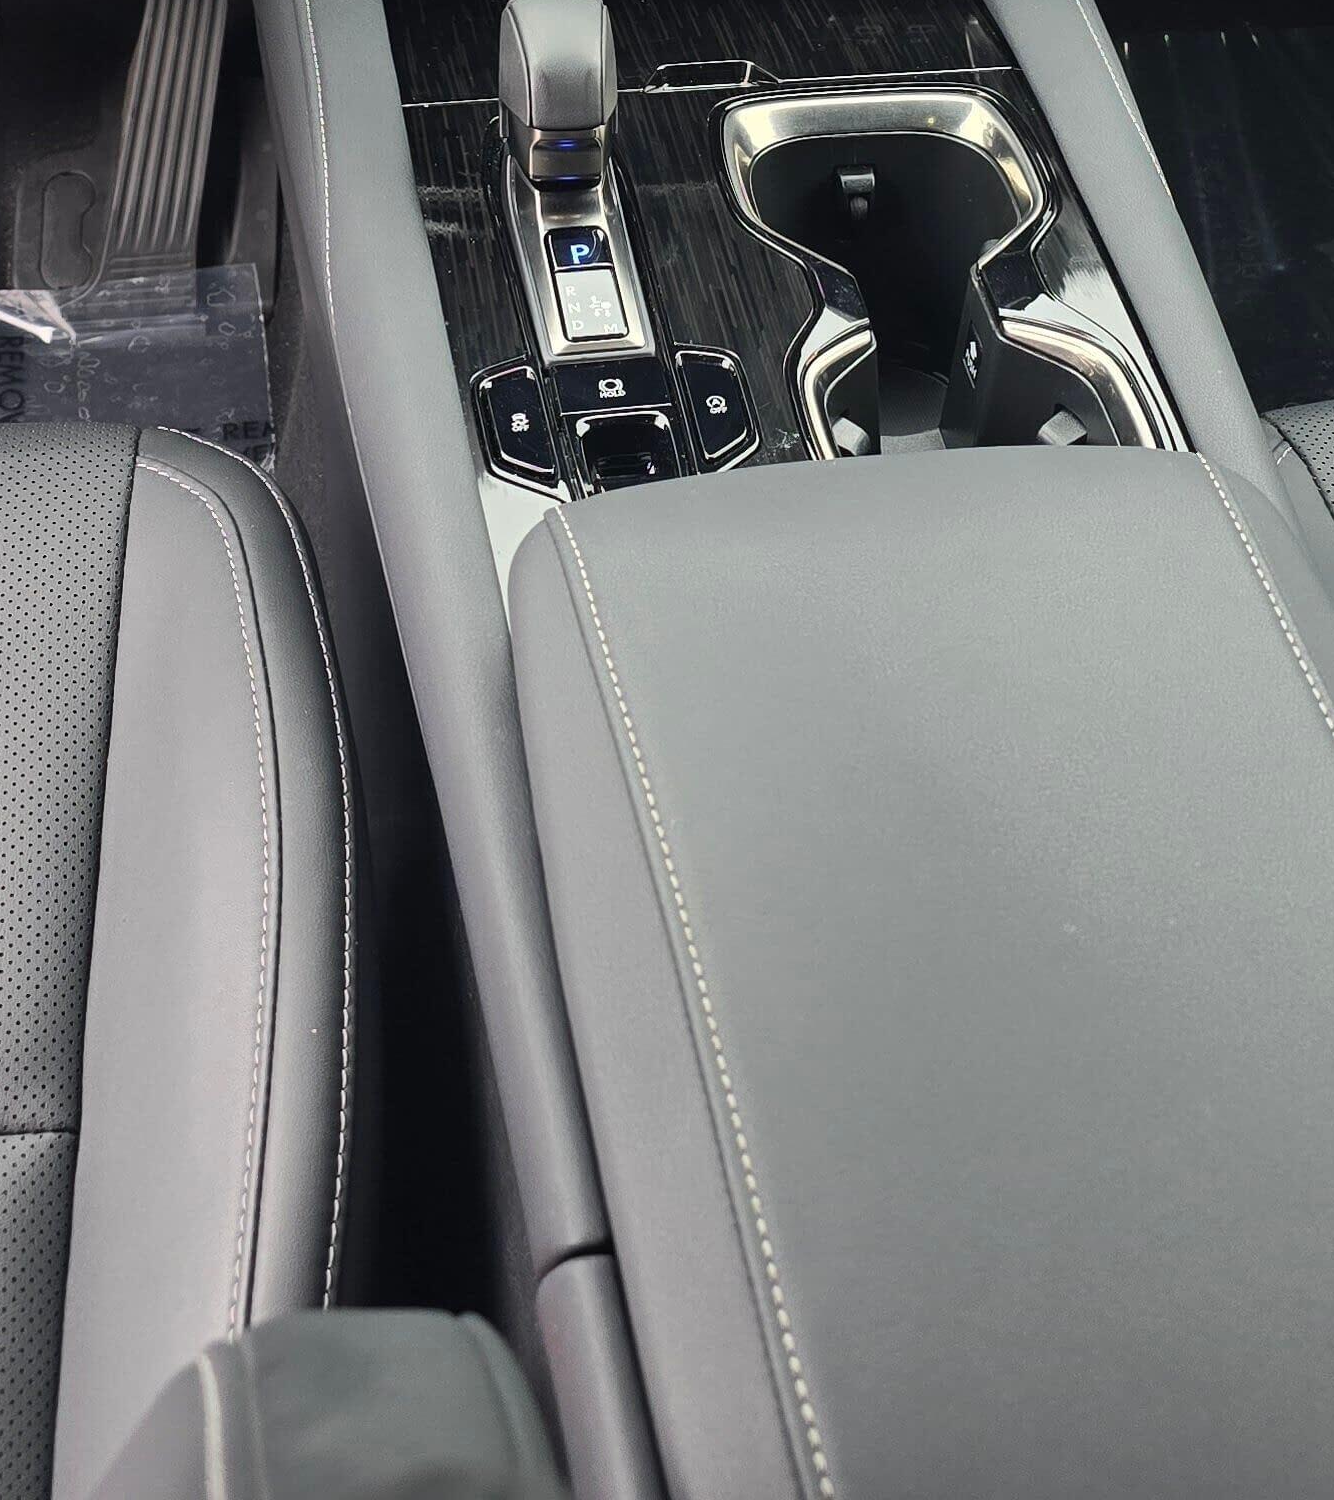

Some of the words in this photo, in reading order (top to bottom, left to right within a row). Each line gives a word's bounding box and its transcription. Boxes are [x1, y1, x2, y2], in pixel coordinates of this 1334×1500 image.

[570, 244, 590, 264] P
[565, 285, 576, 297] R
[567, 302, 581, 314] N
[571, 319, 584, 331] D
[599, 388, 626, 399] HOLD
[709, 405, 728, 415] OFF
[511, 423, 530, 433] OFF
